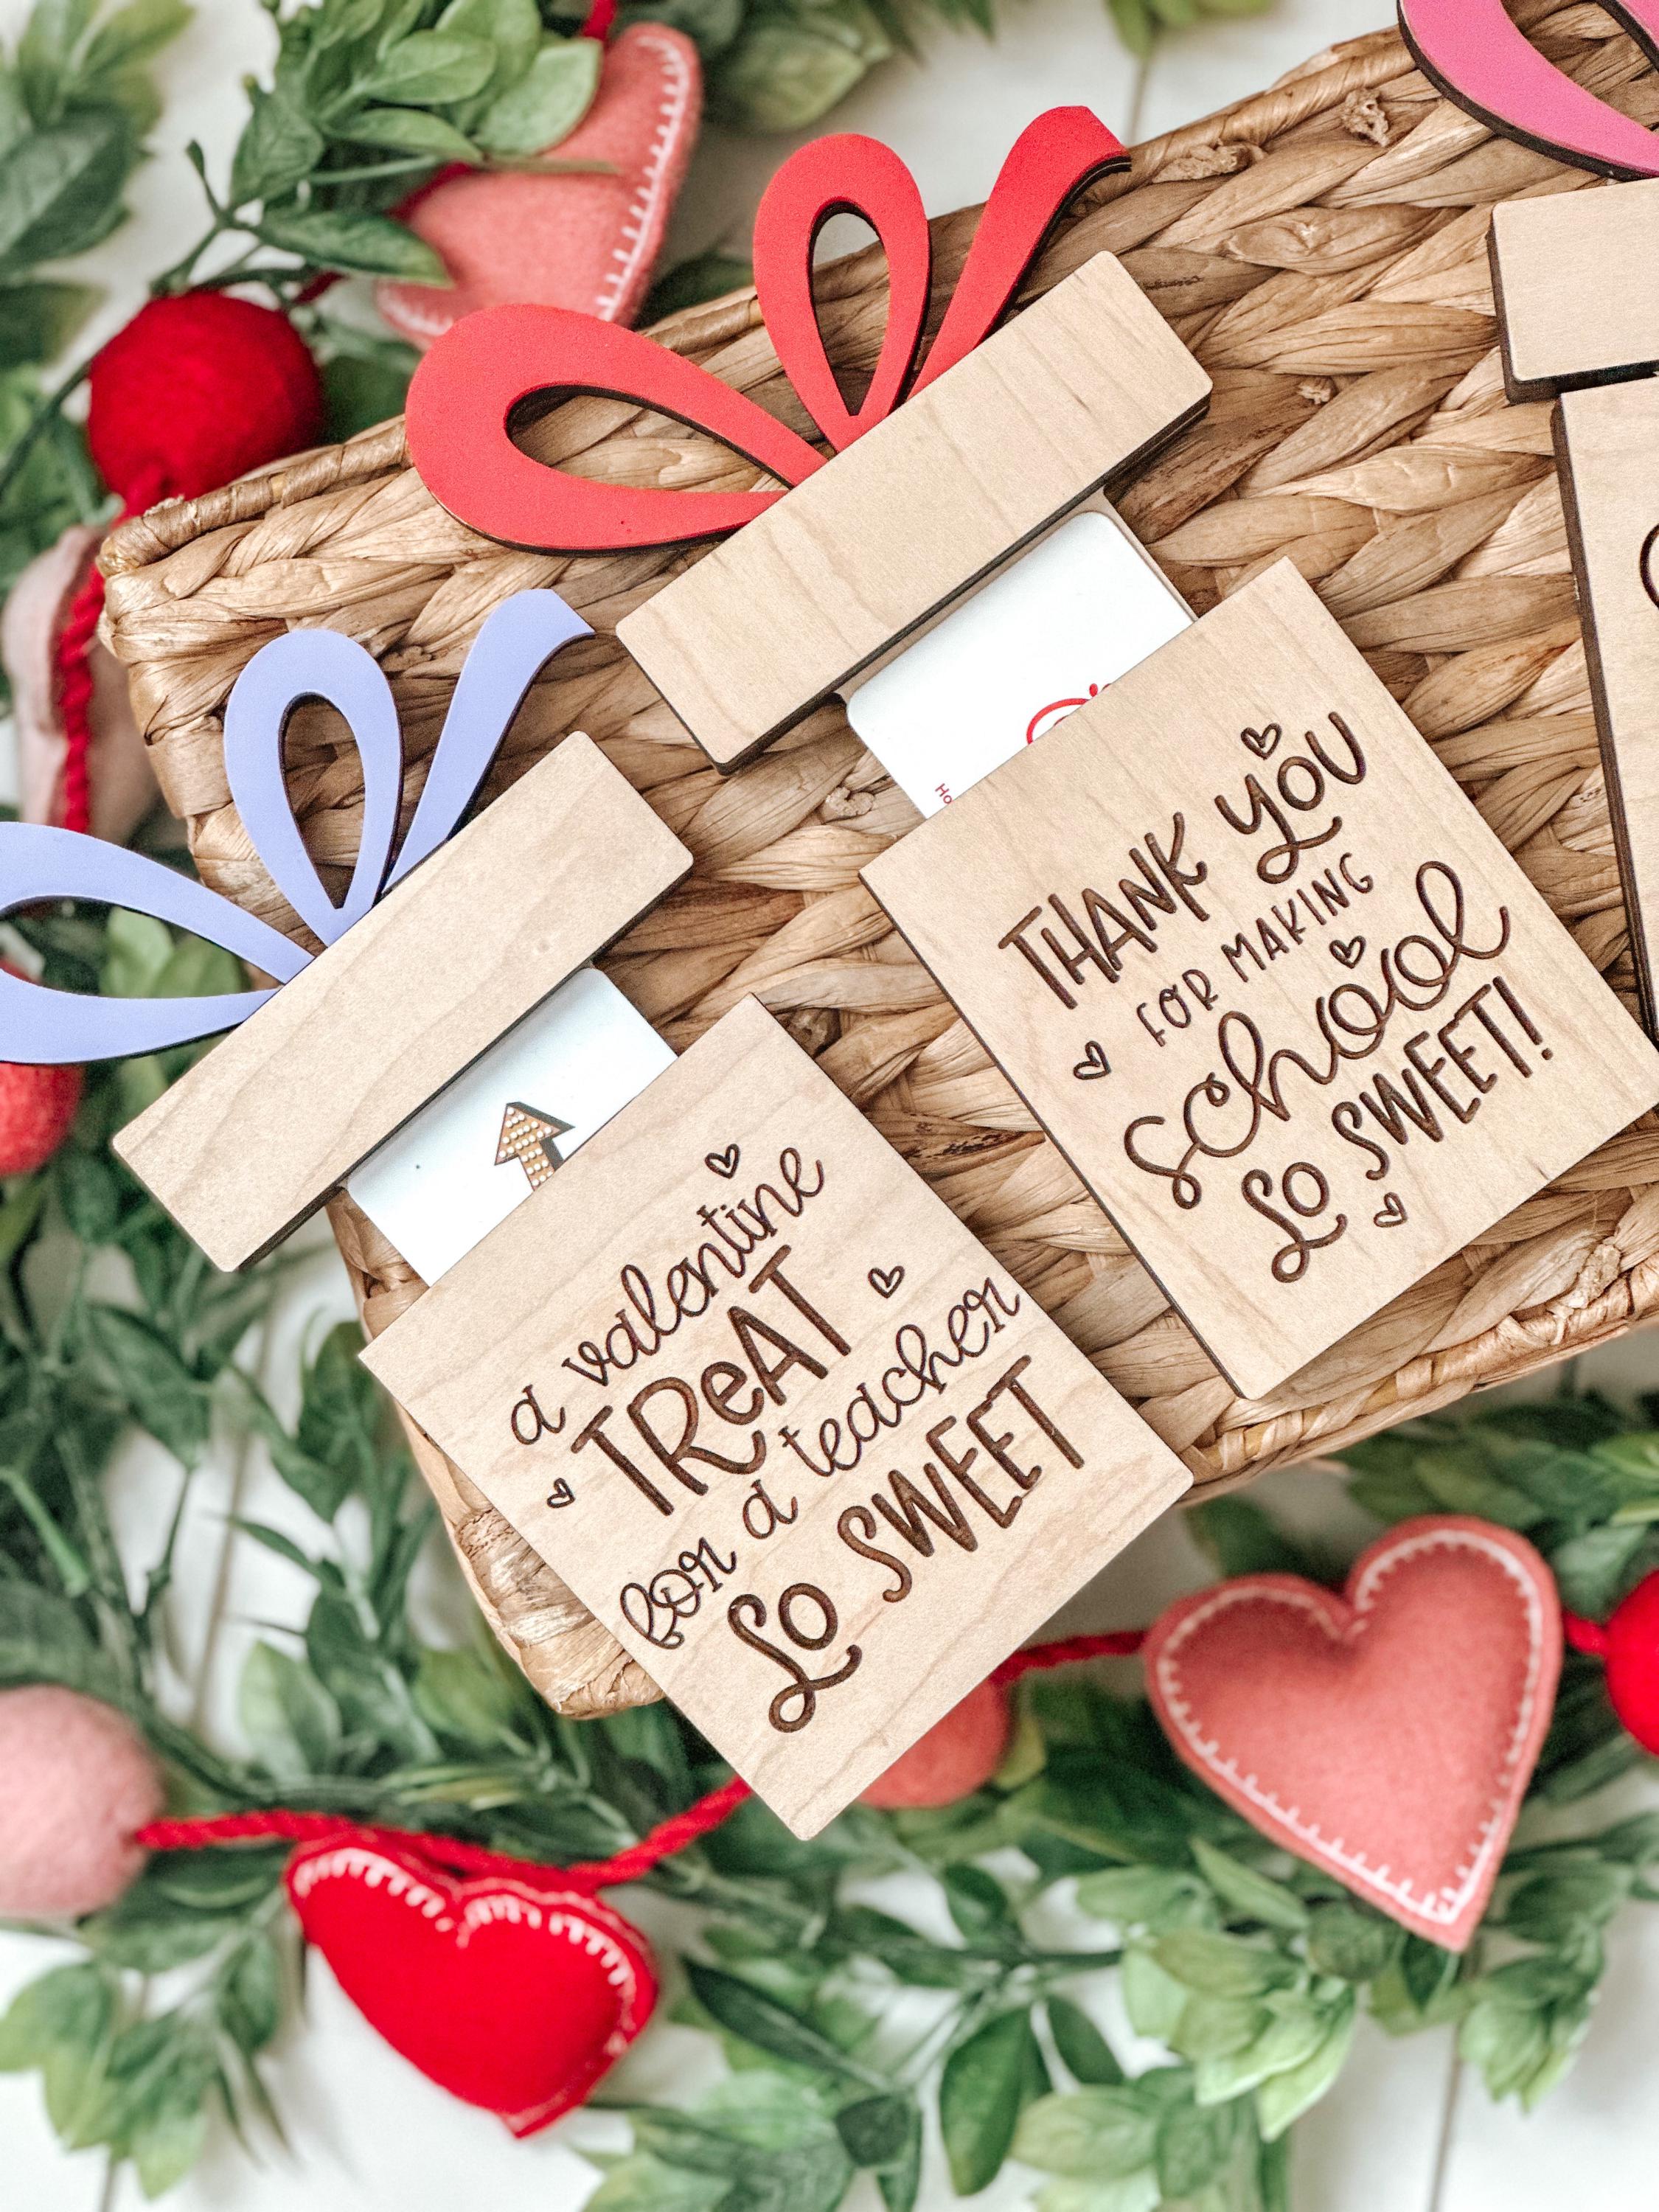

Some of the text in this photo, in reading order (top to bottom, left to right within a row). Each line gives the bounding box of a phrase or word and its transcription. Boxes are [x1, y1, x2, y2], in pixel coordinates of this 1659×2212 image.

[998, 812, 1210, 1009] THANK
[1136, 852, 1374, 1047] FOR MAKING
[1241, 975, 1554, 1283] SO SWEET!
[510, 1147, 825, 1446] a valentine
[619, 1277, 1022, 1650] for a teacher
[727, 1354, 1085, 1733] SO SWEET
